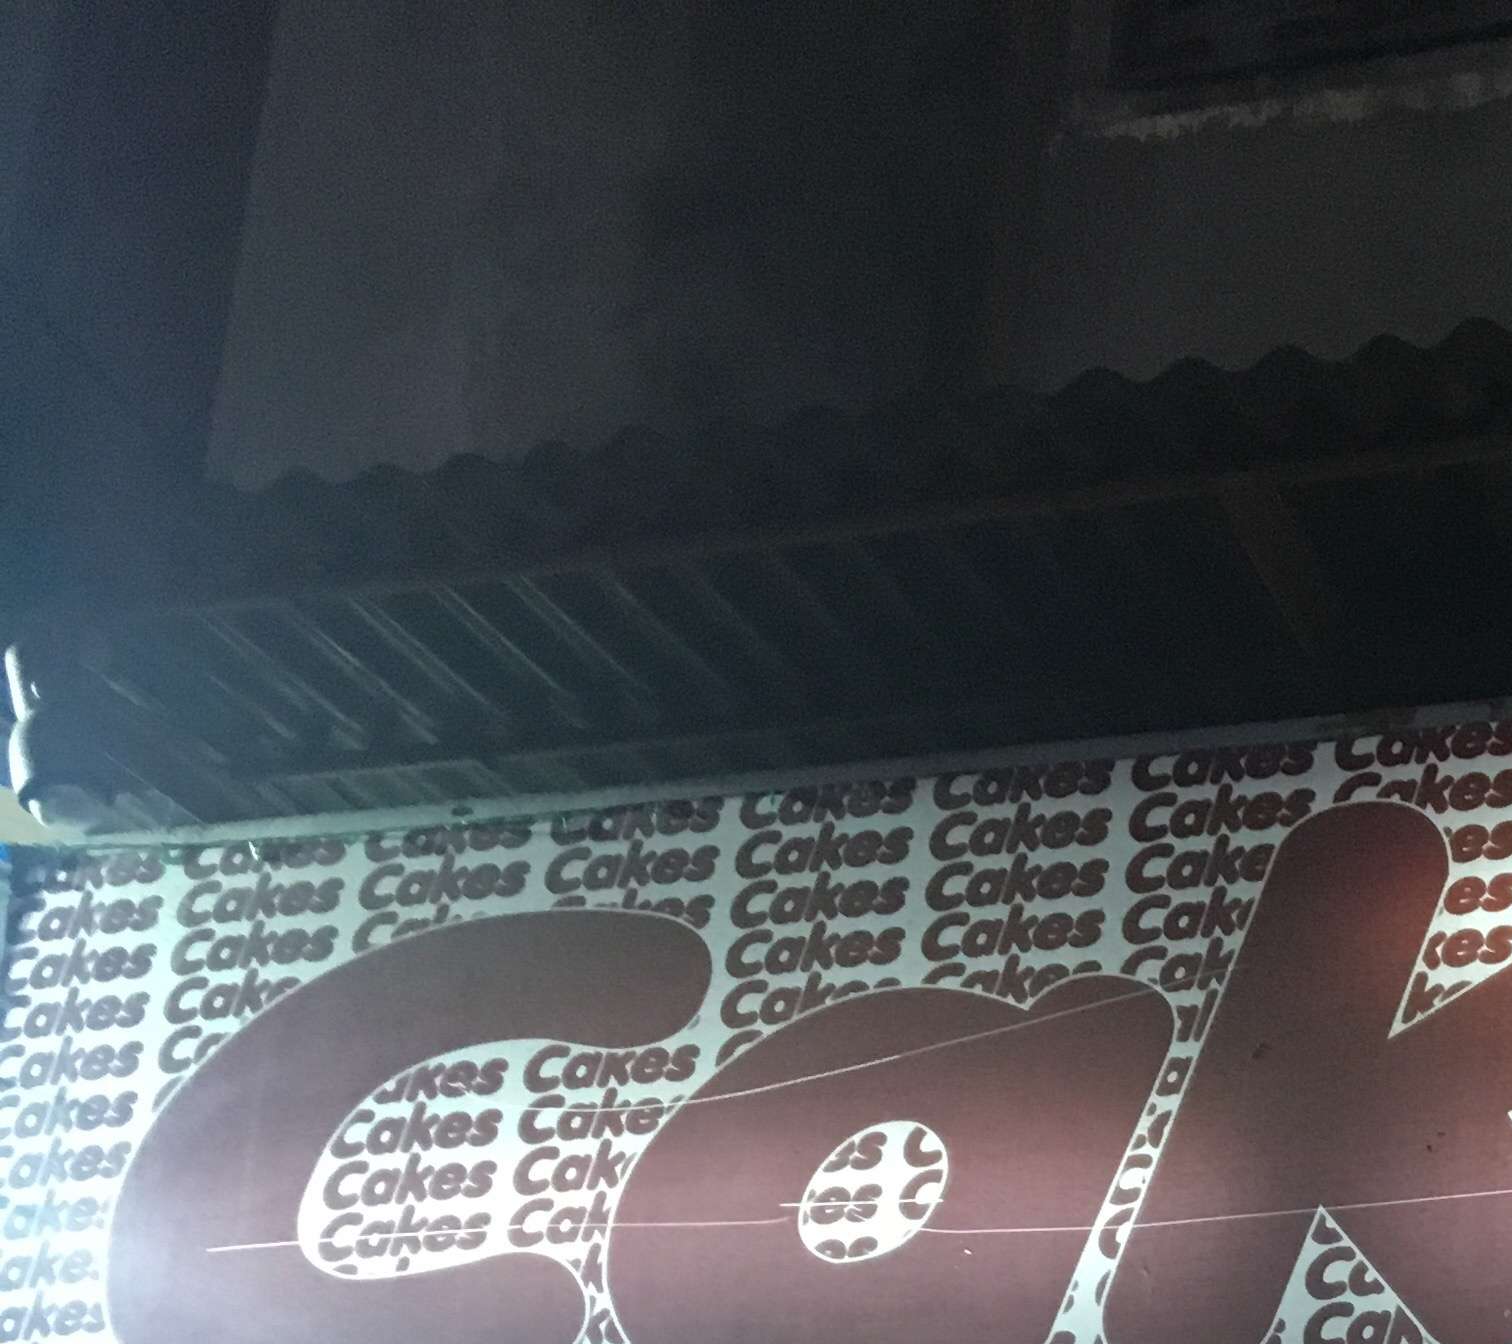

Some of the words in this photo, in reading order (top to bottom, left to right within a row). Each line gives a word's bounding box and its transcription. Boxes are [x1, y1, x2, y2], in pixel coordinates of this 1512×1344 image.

[176, 873, 344, 928] Cakes
[358, 855, 530, 911] Cakes
[544, 838, 719, 894] Cakes
[734, 819, 913, 878] Cakes
[929, 801, 1112, 861] Cakes
[1128, 783, 1315, 842] Cakes
[5, 938, 157, 993] Cakes
[171, 922, 338, 975] Cakes
[730, 870, 909, 928] Cakes
[925, 852, 1109, 911] Cakes
[1125, 833, 1275, 893] Cake
[0, 986, 150, 1042] Cakes
[164, 967, 301, 1024] Cak
[725, 920, 905, 979] Cakes
[921, 903, 1105, 962] Cakes
[1121, 886, 1254, 944] Cak
[522, 1044, 700, 1093] Cakes
[324, 1102, 502, 1158] Cakes
[323, 1154, 497, 1210] Cakes
[512, 1138, 637, 1196] Cak
[318, 1204, 491, 1262] Cakes
[507, 1191, 611, 1248] Cak
